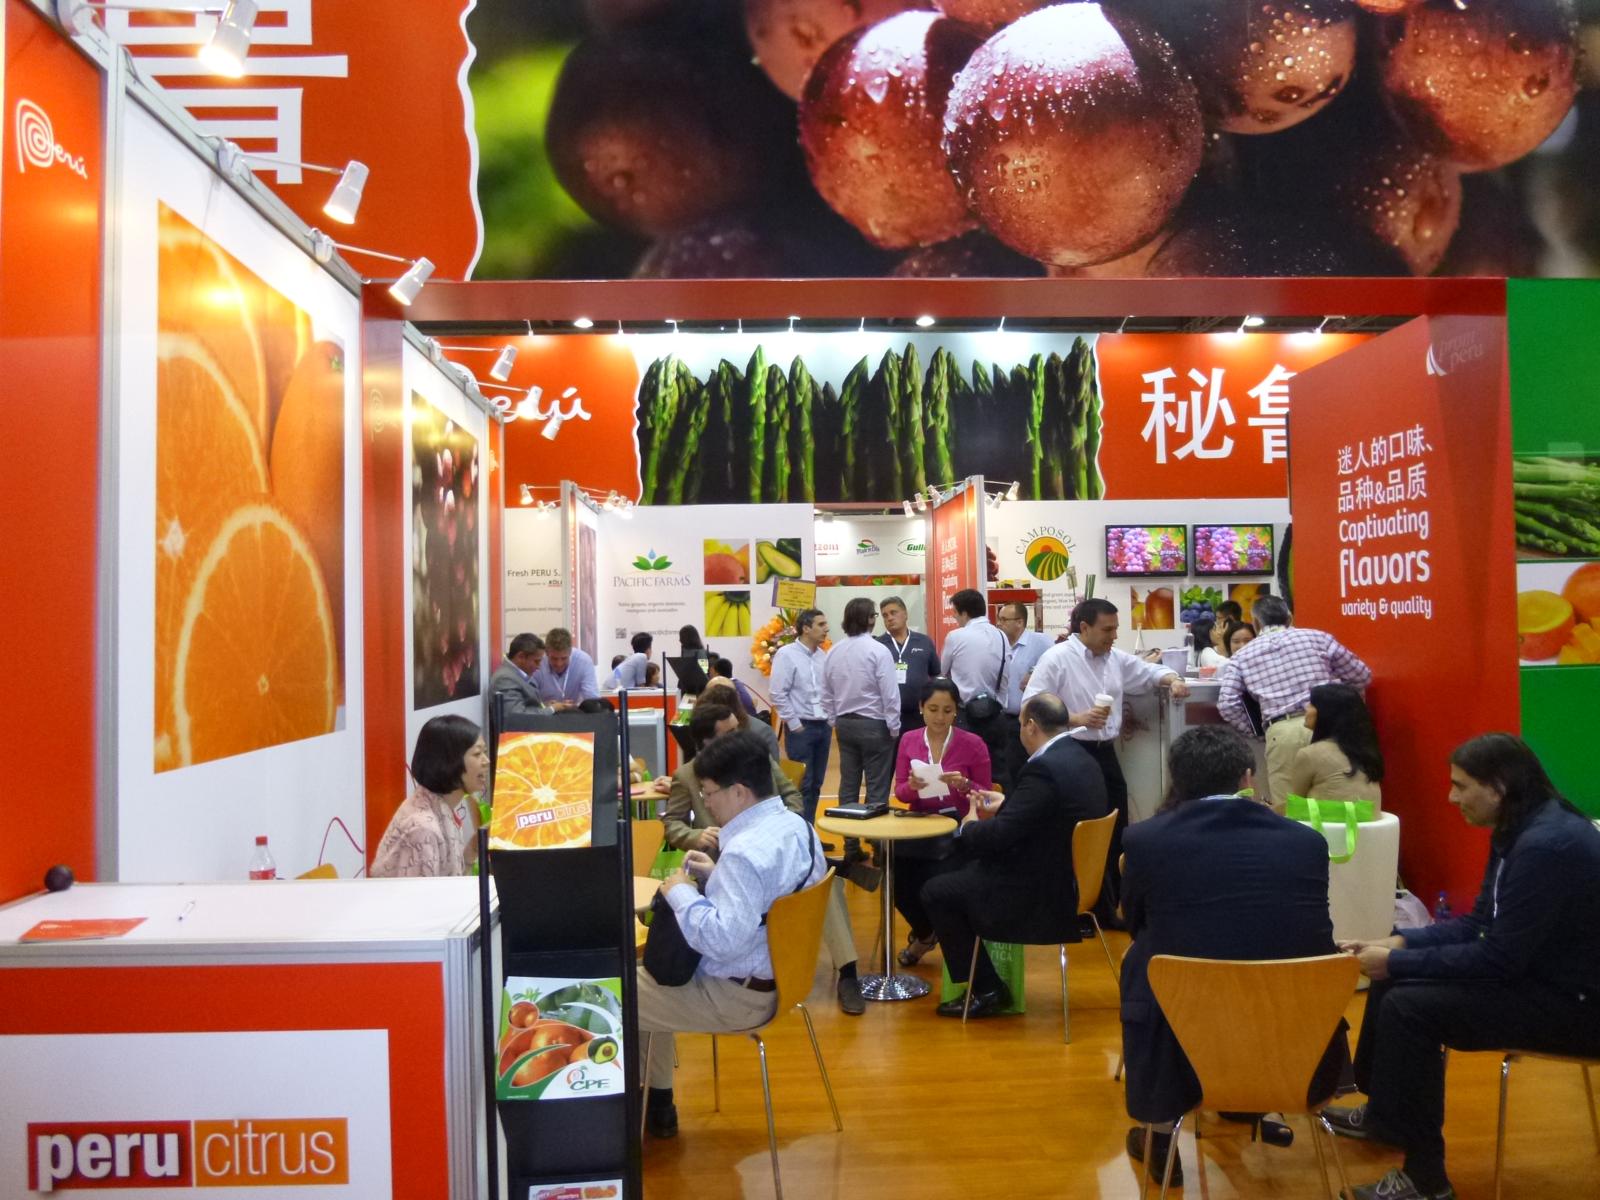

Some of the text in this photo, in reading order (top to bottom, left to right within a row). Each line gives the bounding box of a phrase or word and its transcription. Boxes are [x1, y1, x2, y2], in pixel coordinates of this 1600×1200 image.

[1338, 462, 1428, 514] 品种&品质
[1015, 526, 1077, 555] CAMPOSOL
[1339, 507, 1430, 547] Captivating
[507, 569, 529, 577] Fresh
[531, 569, 552, 577] PERU
[613, 575, 692, 588] PACIFIC FARMS
[1339, 548, 1431, 598] flavors
[1341, 595, 1433, 621] variety & quality
[518, 809, 553, 828] peru
[569, 1078, 611, 1091] CPF
[37, 1119, 336, 1191] peru citrus
